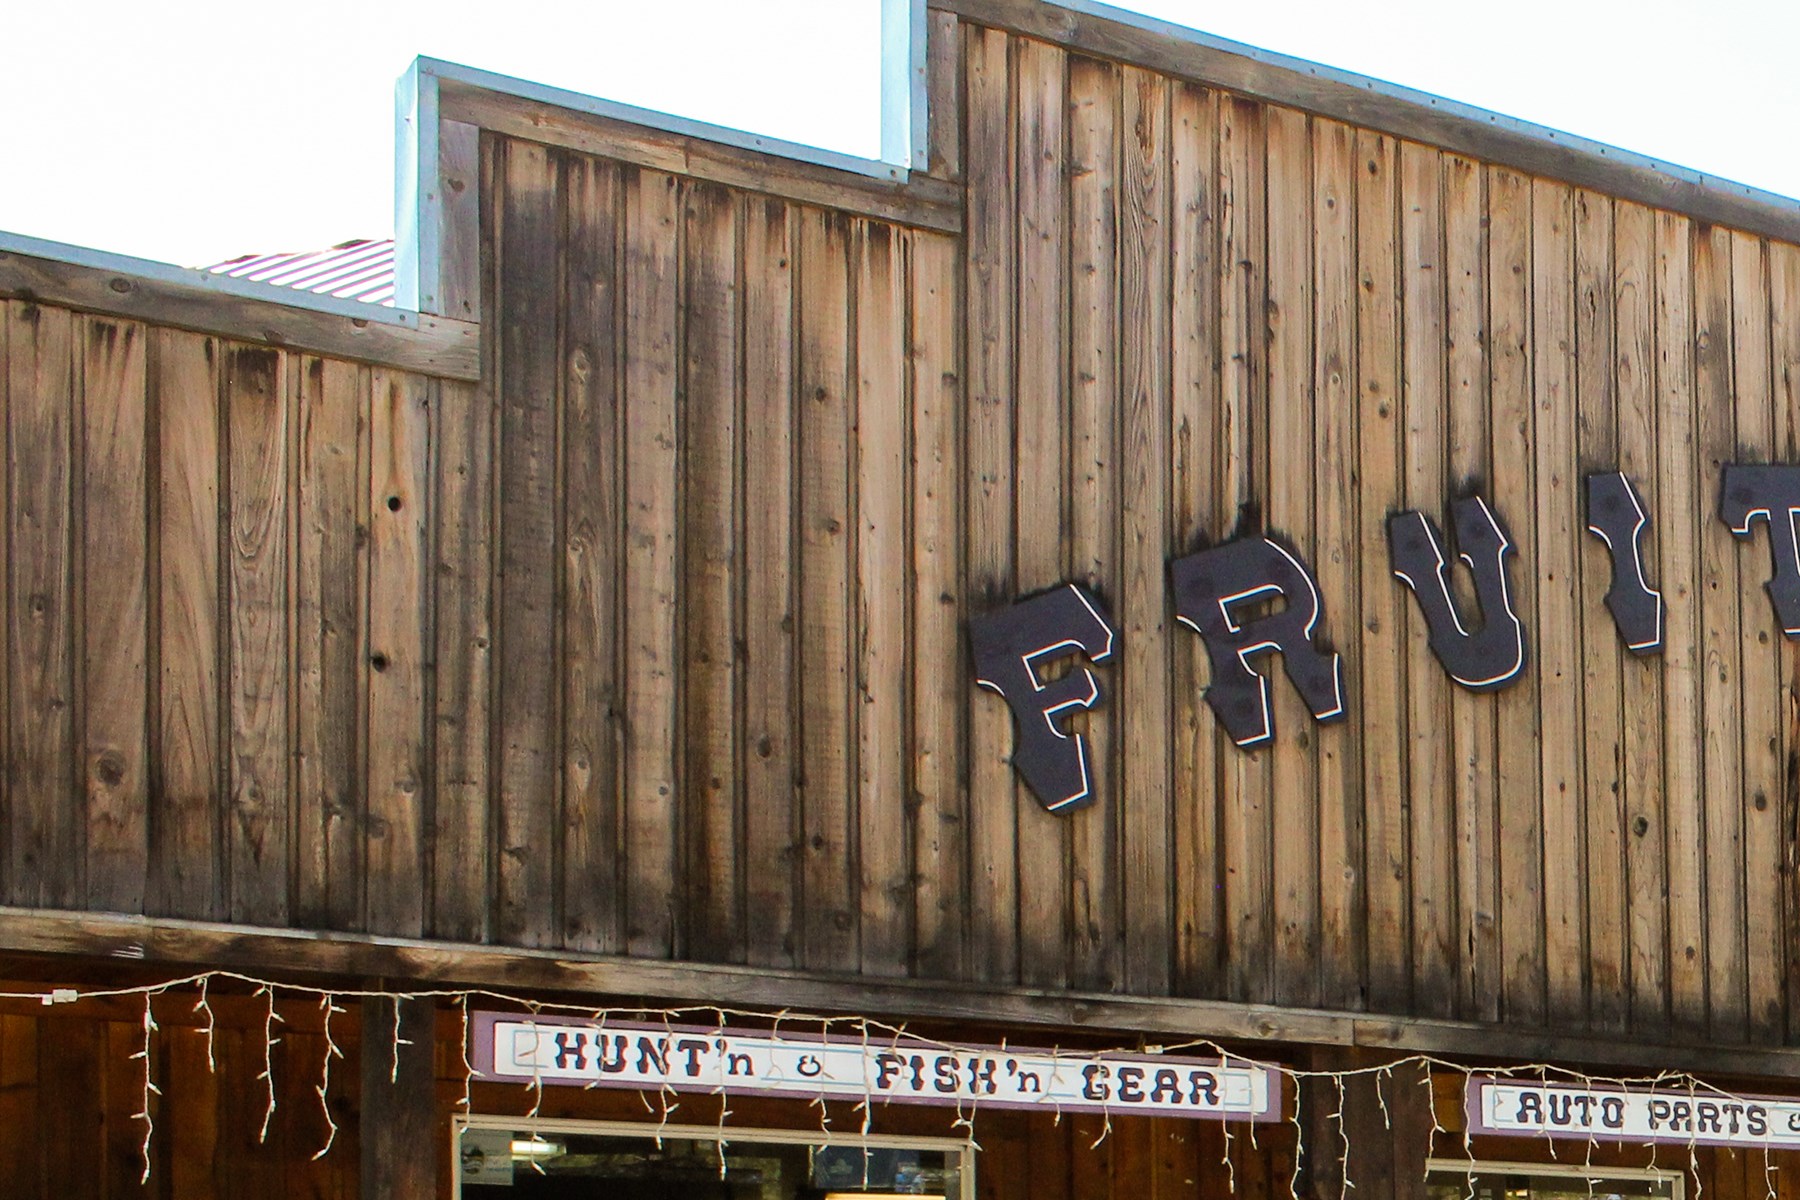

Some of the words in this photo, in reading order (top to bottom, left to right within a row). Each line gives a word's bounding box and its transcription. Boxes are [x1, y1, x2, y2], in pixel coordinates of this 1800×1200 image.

[554, 1032, 754, 1077] HUNT'n
[796, 1054, 822, 1077] &
[876, 1053, 1042, 1095] FISH'n
[1081, 1063, 1222, 1106] GEAR
[1516, 1091, 1626, 1129] AUTO
[1648, 1098, 1767, 1136] PARTS
